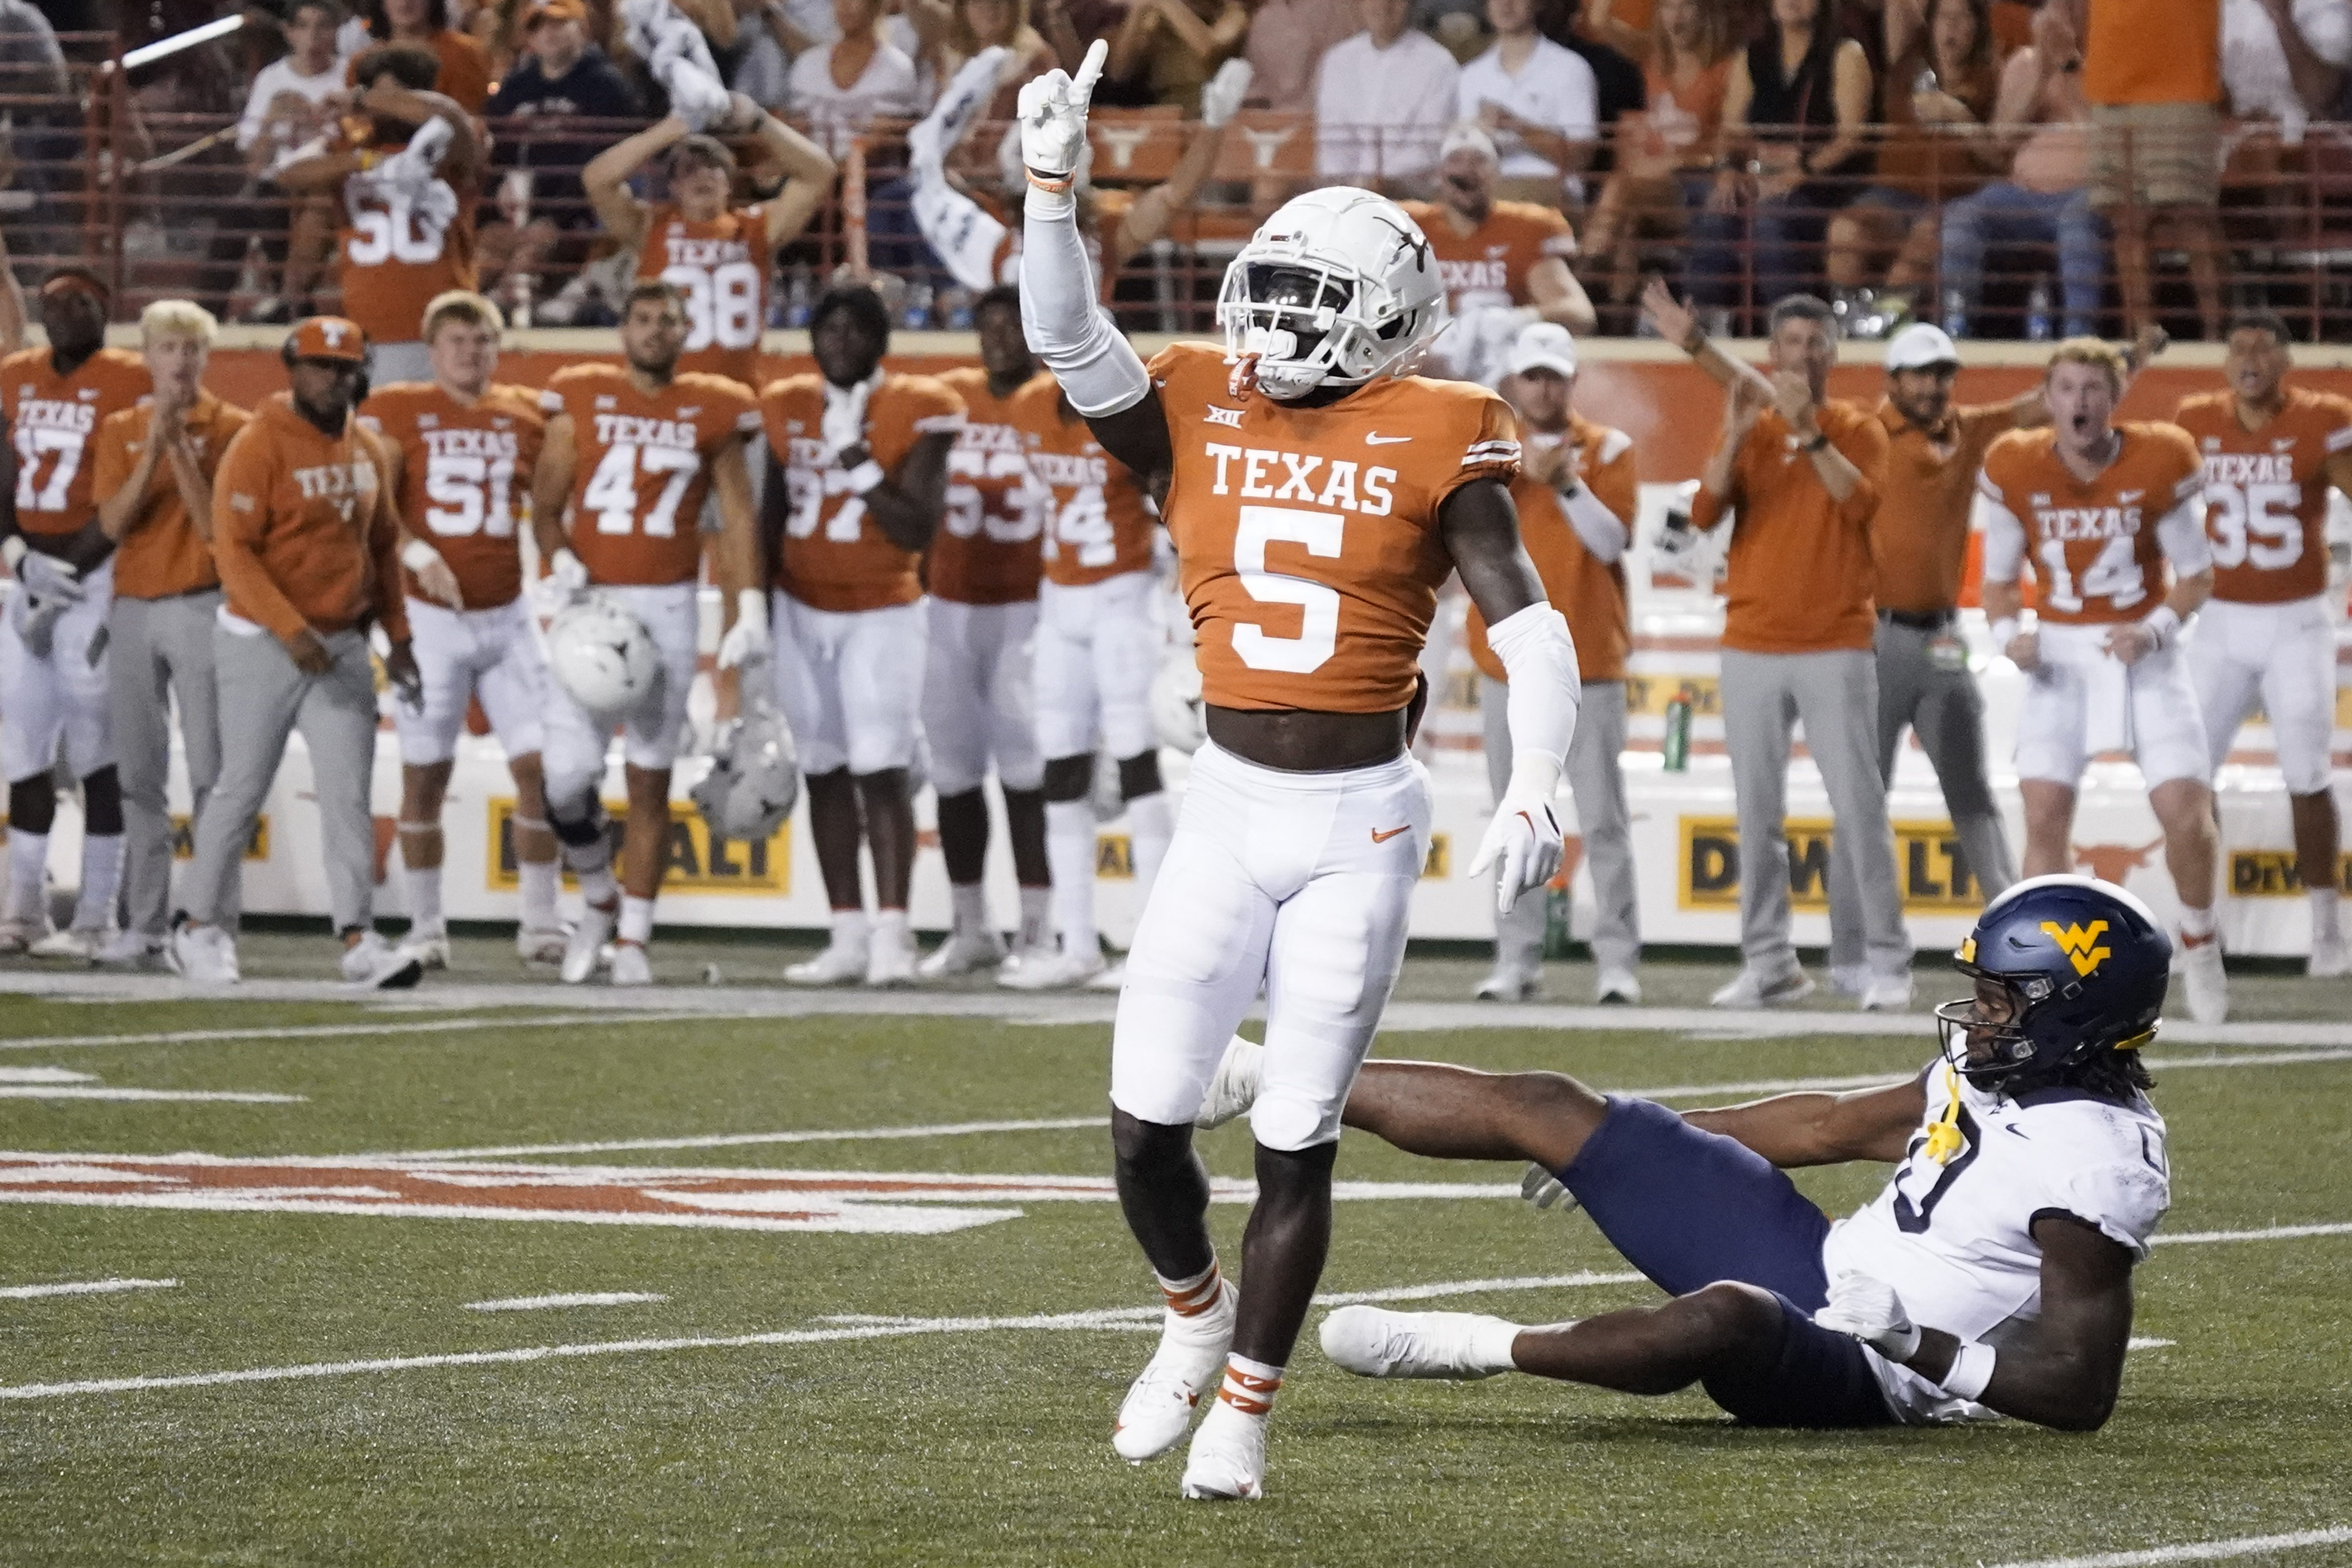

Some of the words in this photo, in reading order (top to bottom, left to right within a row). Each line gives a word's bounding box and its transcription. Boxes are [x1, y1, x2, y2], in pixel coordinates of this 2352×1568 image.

[660, 263, 761, 350] 38
[1438, 259, 1508, 287] EXAS
[421, 430, 519, 459] TEXAS
[594, 413, 697, 448] TEXAS
[2205, 453, 2293, 483] TEXAS
[15, 427, 85, 512] 17
[426, 457, 515, 536] 51
[583, 442, 702, 538] 47
[1205, 442, 1398, 517] TEXAS
[2037, 506, 2142, 538] TEXAS
[2204, 483, 2304, 570] 35
[1232, 505, 1345, 674] 5
[2041, 536, 2147, 613] 14
[1692, 838, 1980, 899] DWLT
